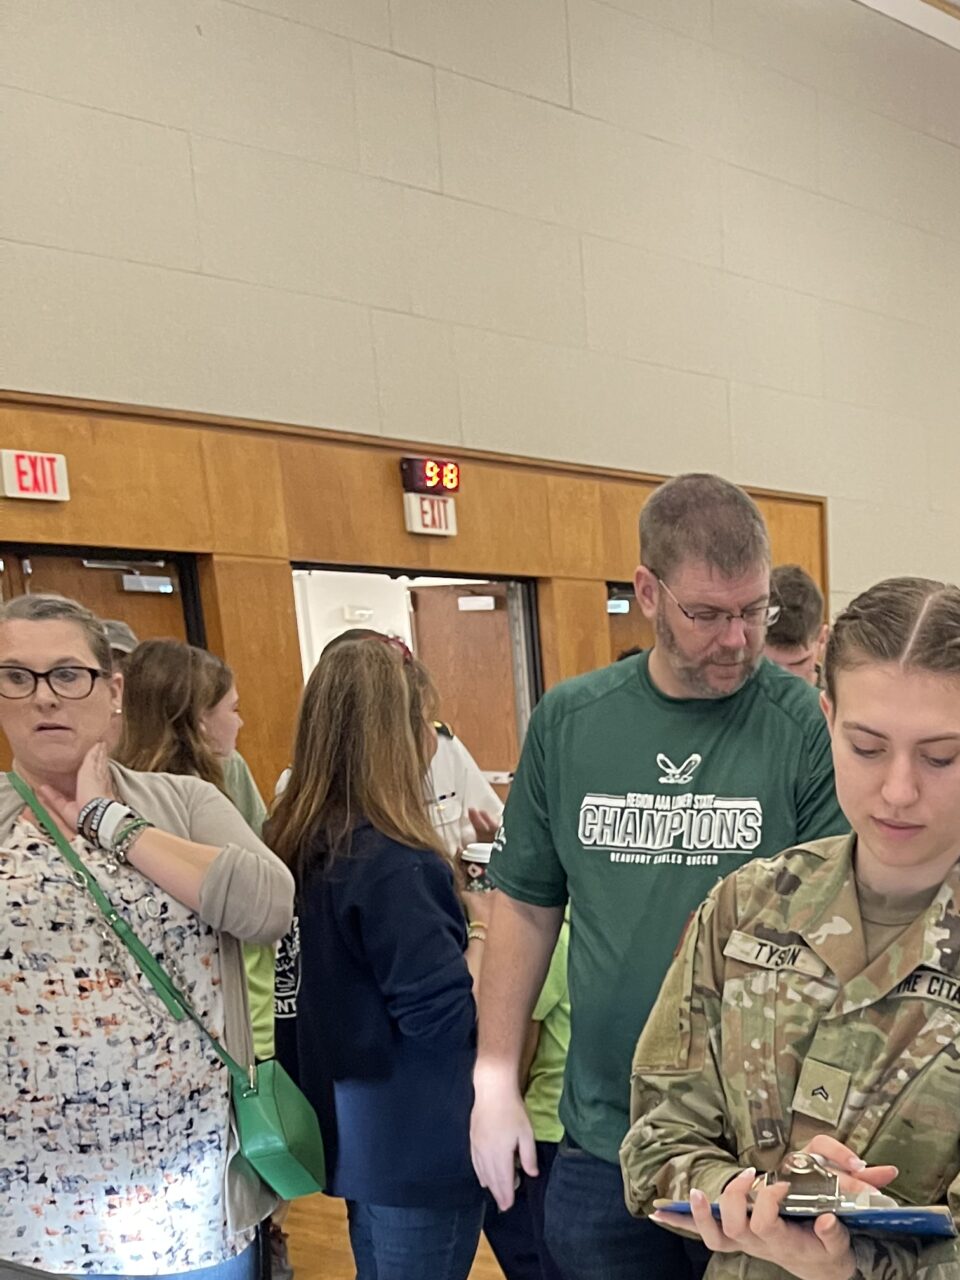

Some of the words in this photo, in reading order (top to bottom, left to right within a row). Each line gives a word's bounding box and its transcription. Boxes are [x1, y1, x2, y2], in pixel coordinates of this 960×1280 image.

[15, 454, 57, 494] EXIT
[420, 497, 448, 530] EXIT
[578, 805, 762, 850] CHAMPIONS
